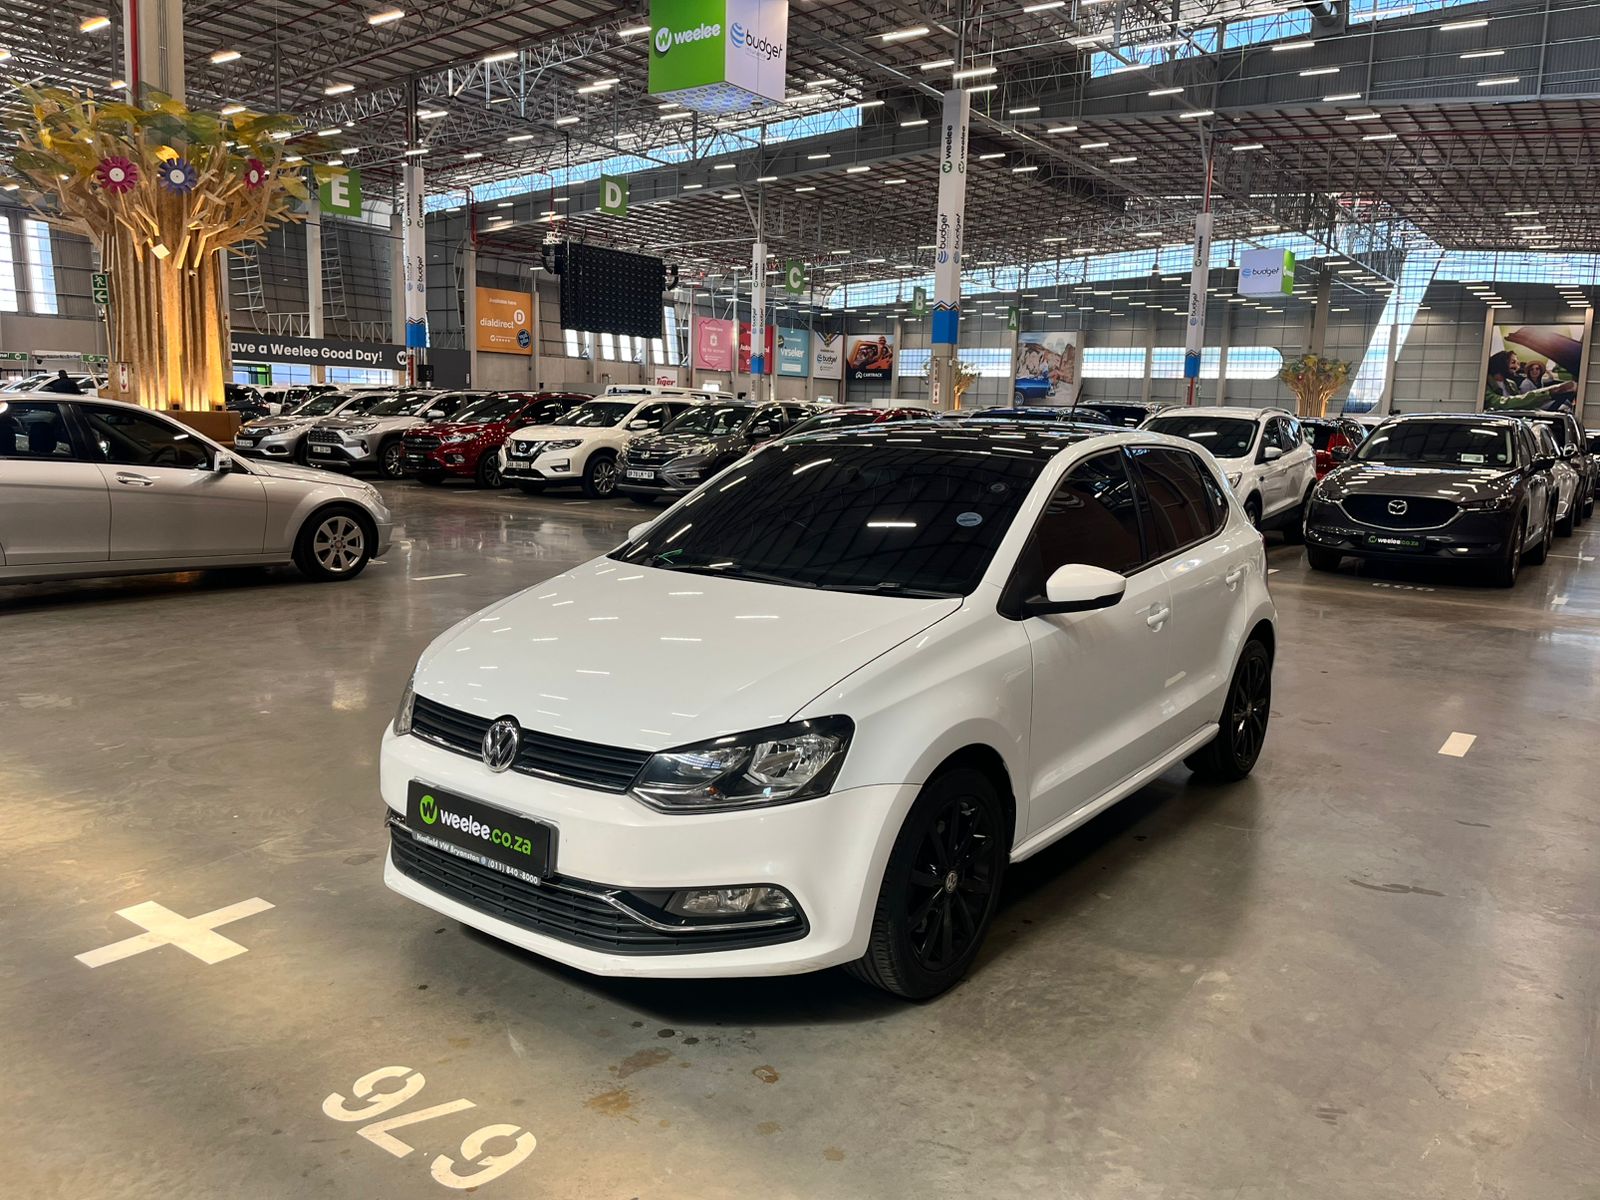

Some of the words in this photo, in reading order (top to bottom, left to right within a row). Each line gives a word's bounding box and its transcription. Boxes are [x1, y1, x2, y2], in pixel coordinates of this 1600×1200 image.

[674, 23, 721, 45] weelee
[745, 29, 783, 61] budget
[945, 124, 953, 159] weelee
[331, 173, 350, 208] E
[605, 181, 622, 208] D
[938, 213, 949, 250] budget
[789, 266, 801, 289] C
[1252, 266, 1280, 277] budget
[915, 291, 924, 311] B
[480, 317, 514, 329] dialdirect
[1009, 310, 1017, 327] A
[230, 342, 256, 354] ave
[258, 345, 268, 354] a
[270, 343, 319, 358] Weelee
[321, 347, 353, 360] Good
[355, 350, 383, 365] Day!
[656, 376, 676, 387] Tiger
[1377, 537, 1418, 546] weelee.co.za
[440, 809, 532, 856] weelee.co.za
[438, 840, 450, 852] VW
[449, 843, 480, 863] Bryanston
[487, 859, 505, 873] (011)
